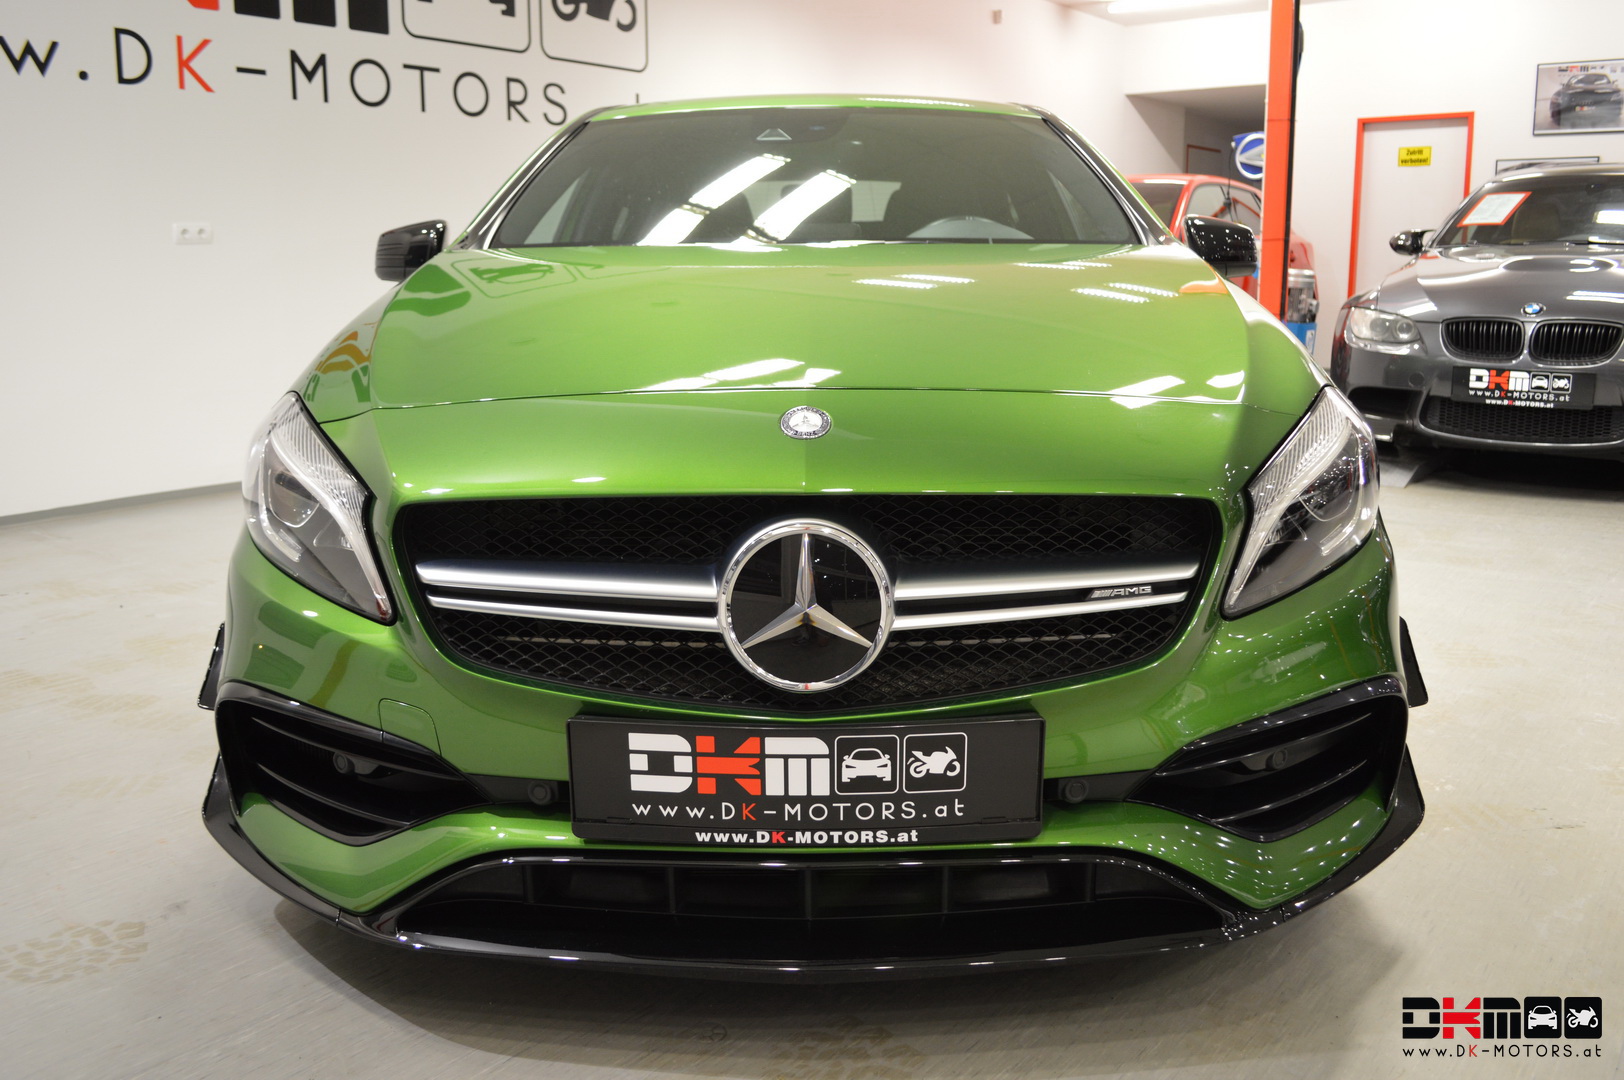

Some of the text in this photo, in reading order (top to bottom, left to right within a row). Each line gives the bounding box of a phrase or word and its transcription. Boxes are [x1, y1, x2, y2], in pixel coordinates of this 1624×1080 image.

[1111, 586, 1151, 597] AMG
[632, 798, 965, 821] www.DK-MOTORS.at
[695, 829, 919, 844] www.DK-MOTORS.at
